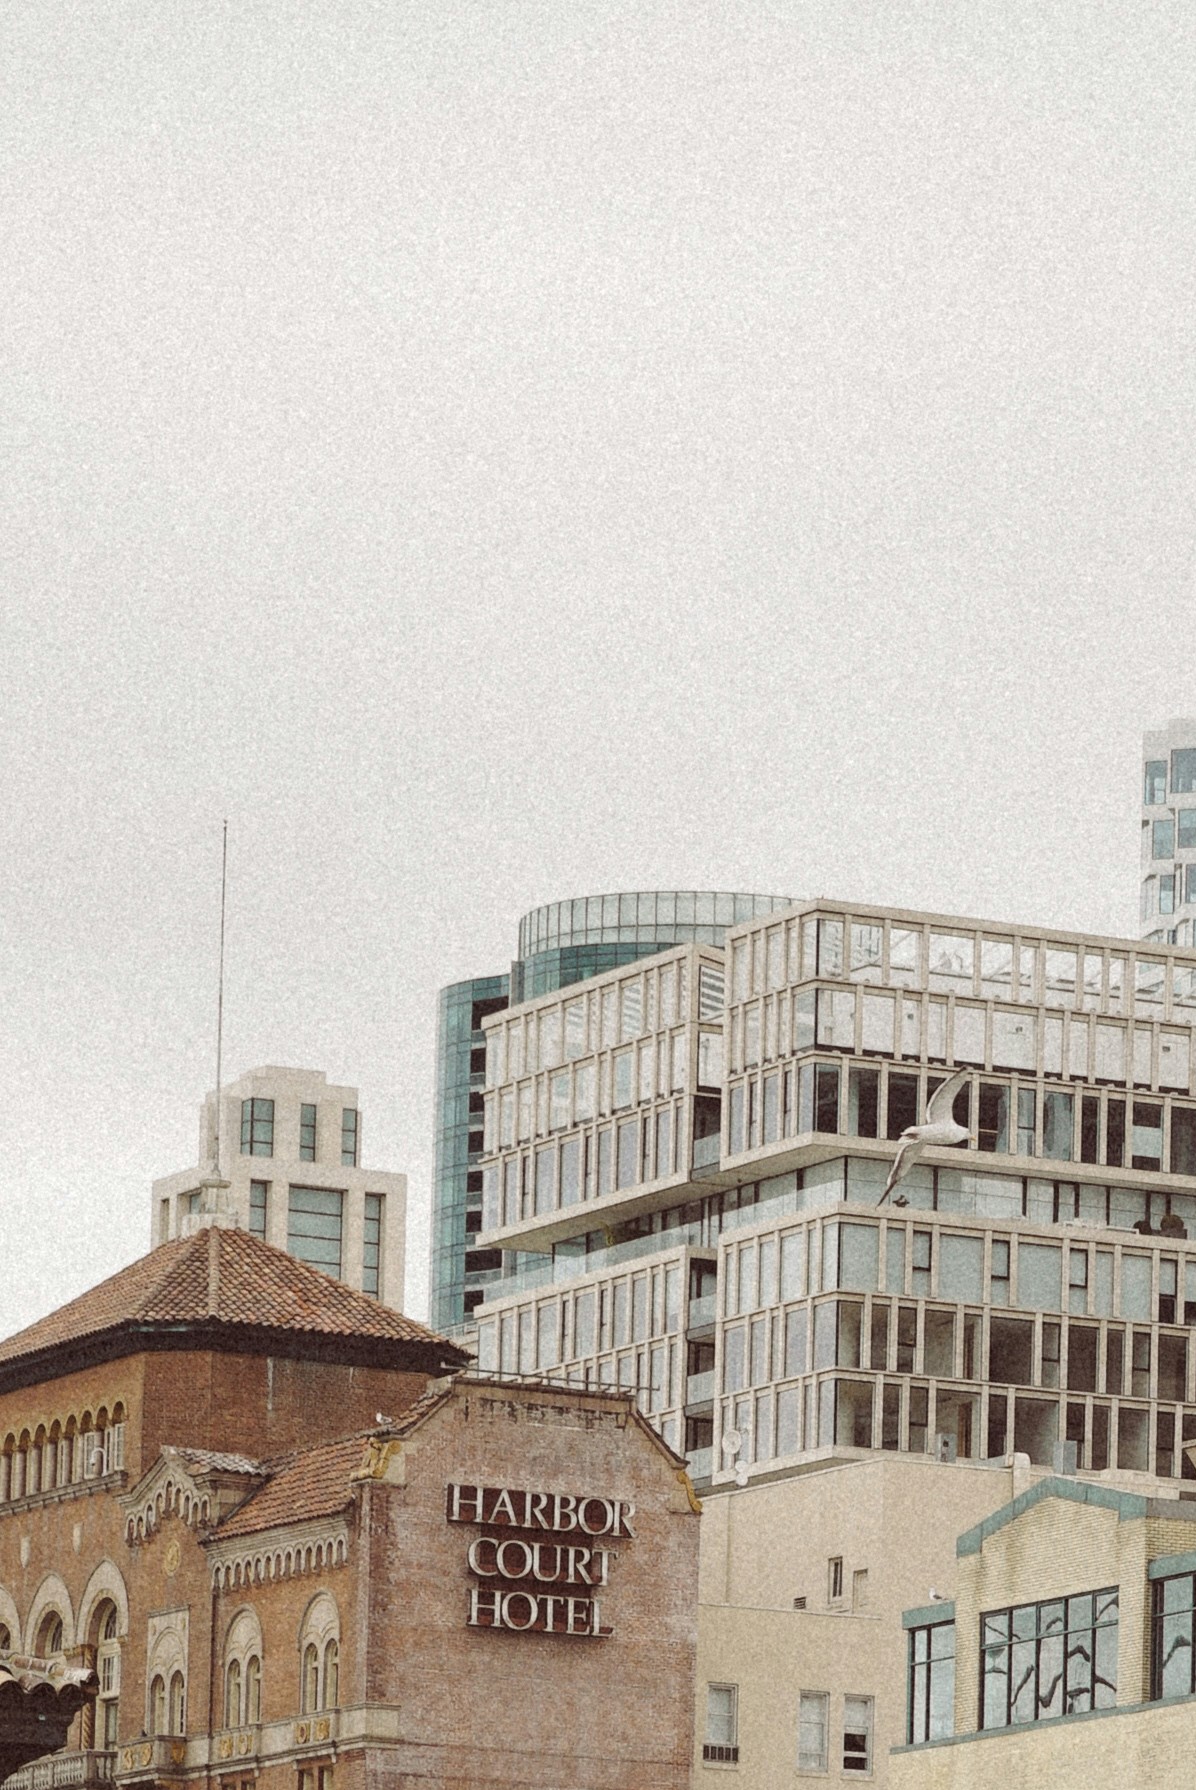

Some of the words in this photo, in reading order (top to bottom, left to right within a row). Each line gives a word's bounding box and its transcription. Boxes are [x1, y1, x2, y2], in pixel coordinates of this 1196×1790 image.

[449, 1484, 639, 1538] HARBOR
[467, 1537, 619, 1586] COURT
[467, 1588, 614, 1638] HOTEL
